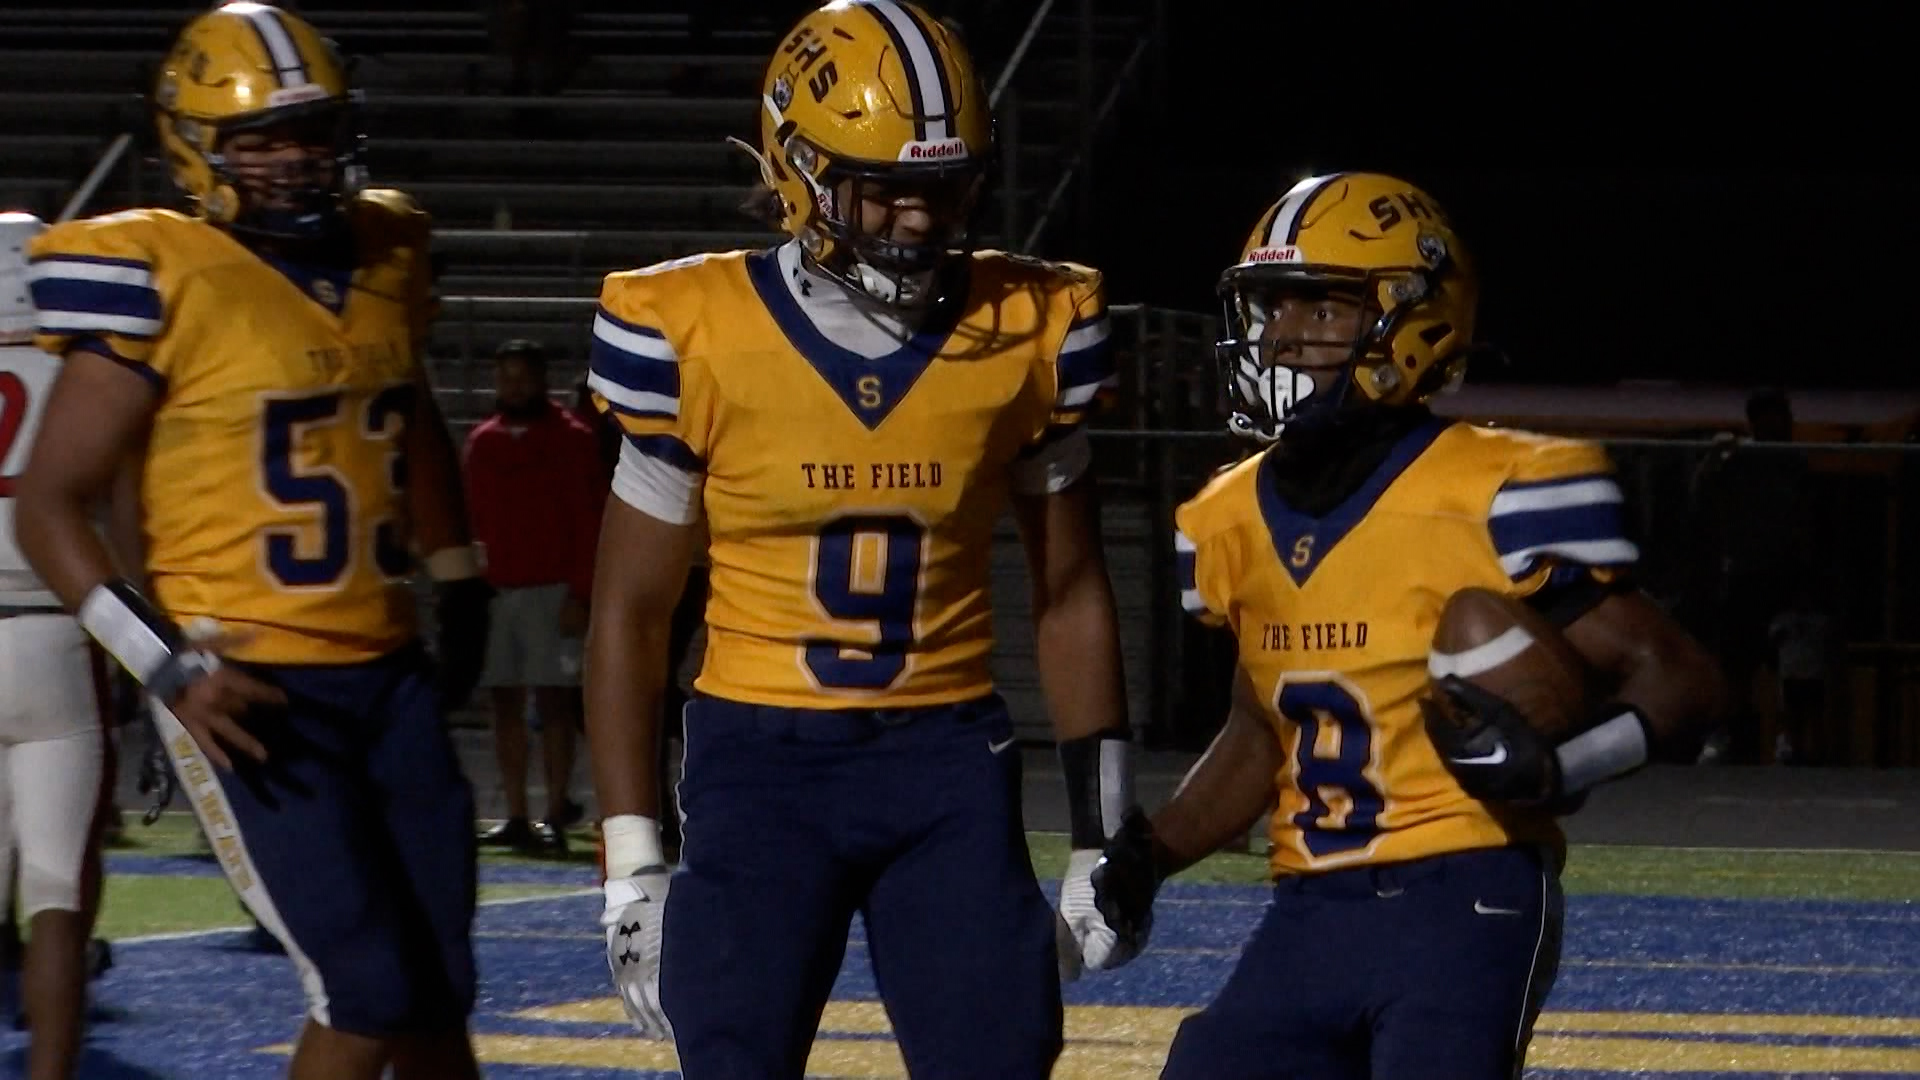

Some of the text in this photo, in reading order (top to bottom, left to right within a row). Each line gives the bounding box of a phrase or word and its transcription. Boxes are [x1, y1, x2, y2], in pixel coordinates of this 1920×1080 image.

[783, 27, 838, 104] SHS
[910, 142, 963, 159] Riddell
[1249, 249, 1296, 263] Riddell
[857, 375, 882, 408] S
[259, 387, 415, 592] 53
[801, 462, 943, 490] THE FIELD
[1289, 535, 1315, 568] S
[798, 510, 931, 694] 9
[1261, 622, 1369, 651] THE FIELD
[1272, 671, 1391, 870] 8
